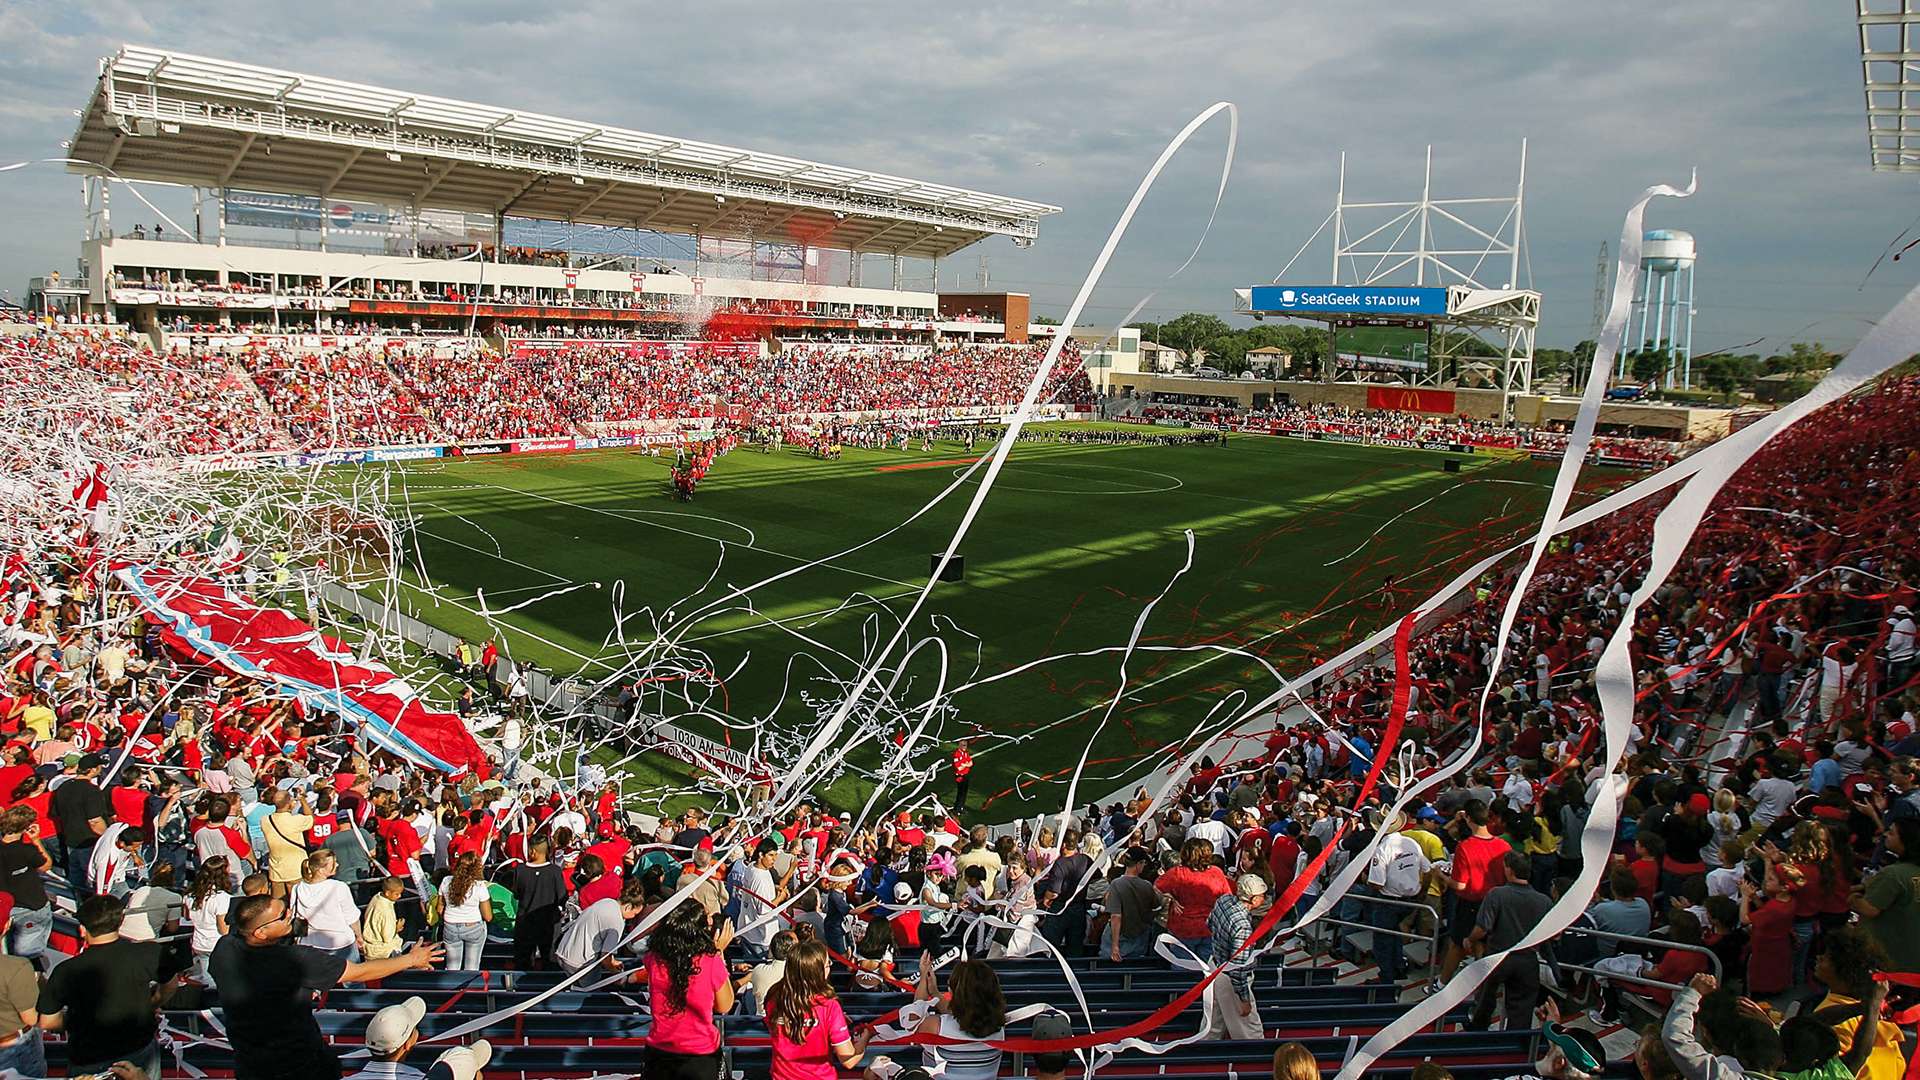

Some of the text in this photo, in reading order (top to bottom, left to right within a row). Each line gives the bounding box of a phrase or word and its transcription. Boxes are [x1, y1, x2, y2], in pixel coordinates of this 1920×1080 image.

[1301, 292, 1420, 307] SeatGeek STADIUM
[634, 434, 687, 445] HONDA
[1370, 438, 1420, 449] HONDA
[463, 446, 502, 455] RadioShack
[519, 441, 569, 452] Budweiser
[1424, 442, 1450, 451] adidas
[374, 447, 437, 461] Panasonic
[673, 728, 696, 749] 1030
[699, 738, 715, 756] AM
[663, 745, 693, 764] Polskie
[313, 823, 331, 838] 98
